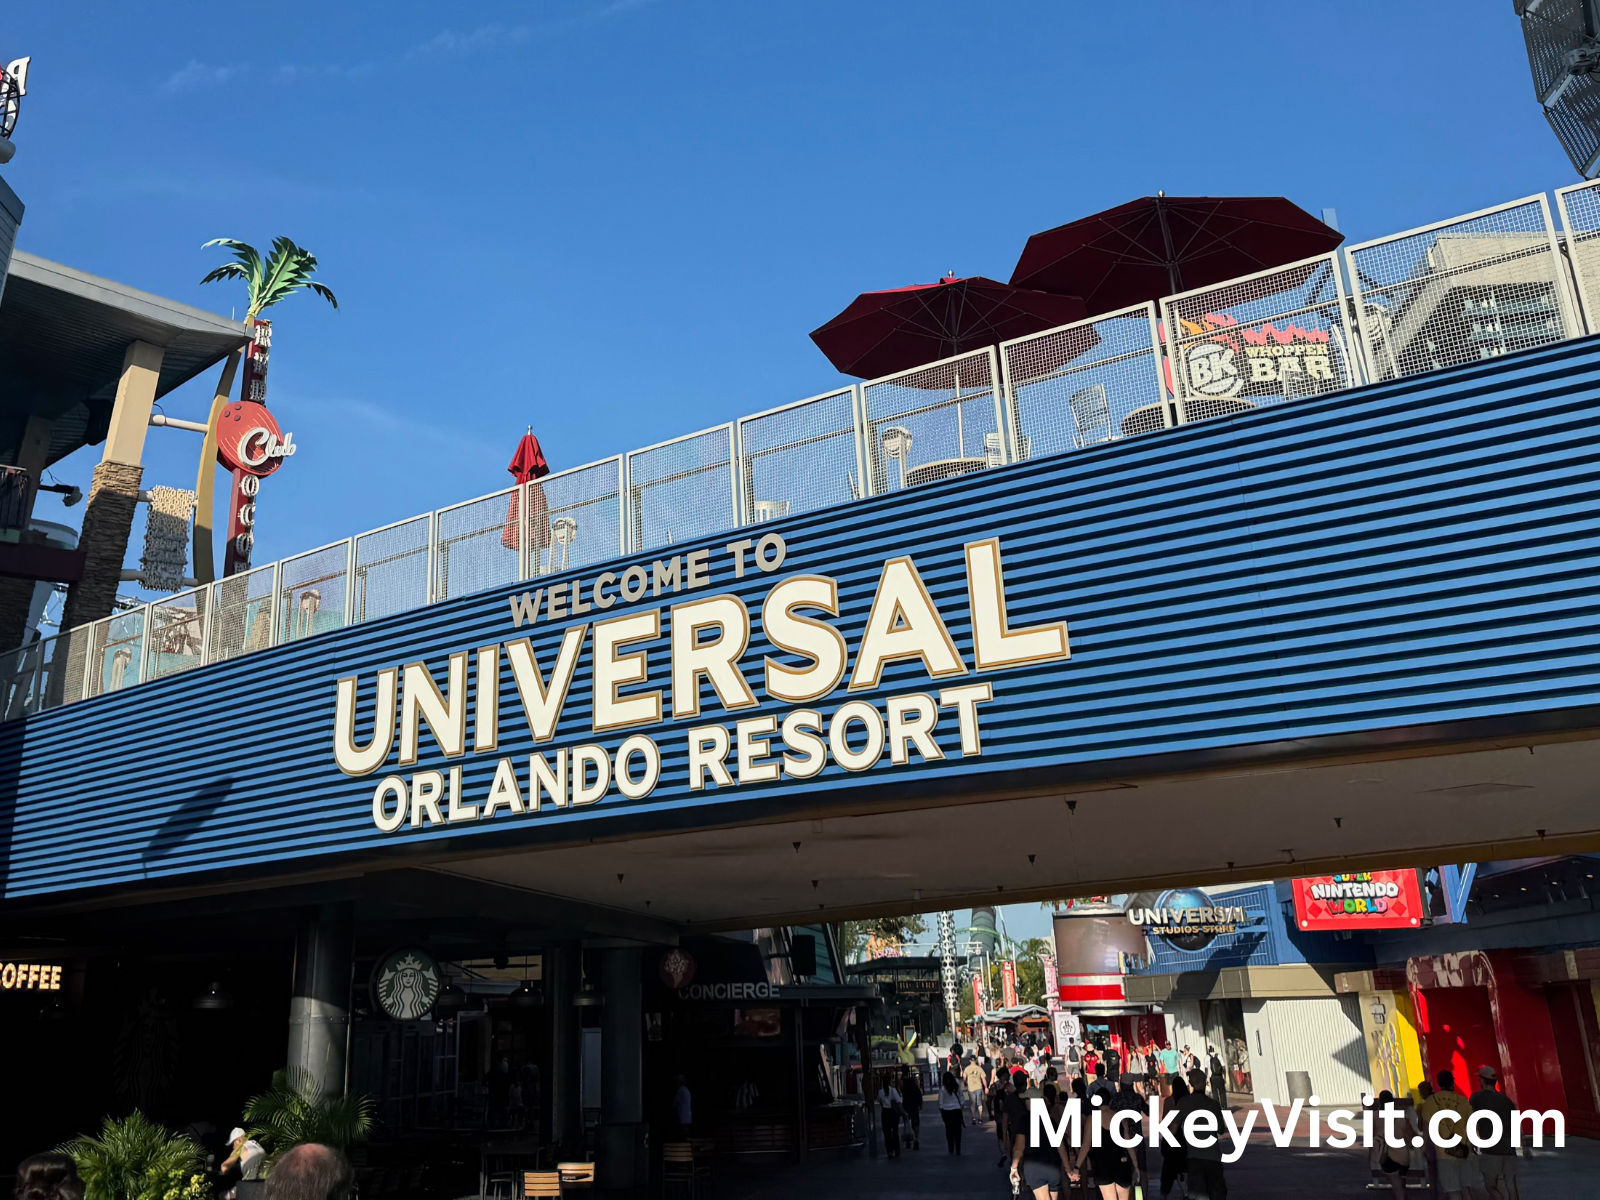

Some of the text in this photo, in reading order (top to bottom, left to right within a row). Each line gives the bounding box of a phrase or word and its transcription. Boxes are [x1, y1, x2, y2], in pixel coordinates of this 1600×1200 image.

[1244, 343, 1329, 357] WHOPPER
[1189, 347, 1238, 386] BK
[1248, 354, 1335, 383] BAR
[237, 427, 297, 466] Club
[509, 533, 787, 628] WELCOME TO
[333, 536, 1072, 778] UNIVERSAL
[371, 681, 994, 834] ORLANDO RESORT
[1310, 881, 1400, 899] NINTENDO
[1128, 905, 1252, 926] UNIVERSAL
[1327, 898, 1388, 914] WORLD
[1152, 925, 1236, 935] STUDIOS STORE
[0, 962, 62, 990] OFFEE
[678, 982, 781, 1000] CONCIERGE
